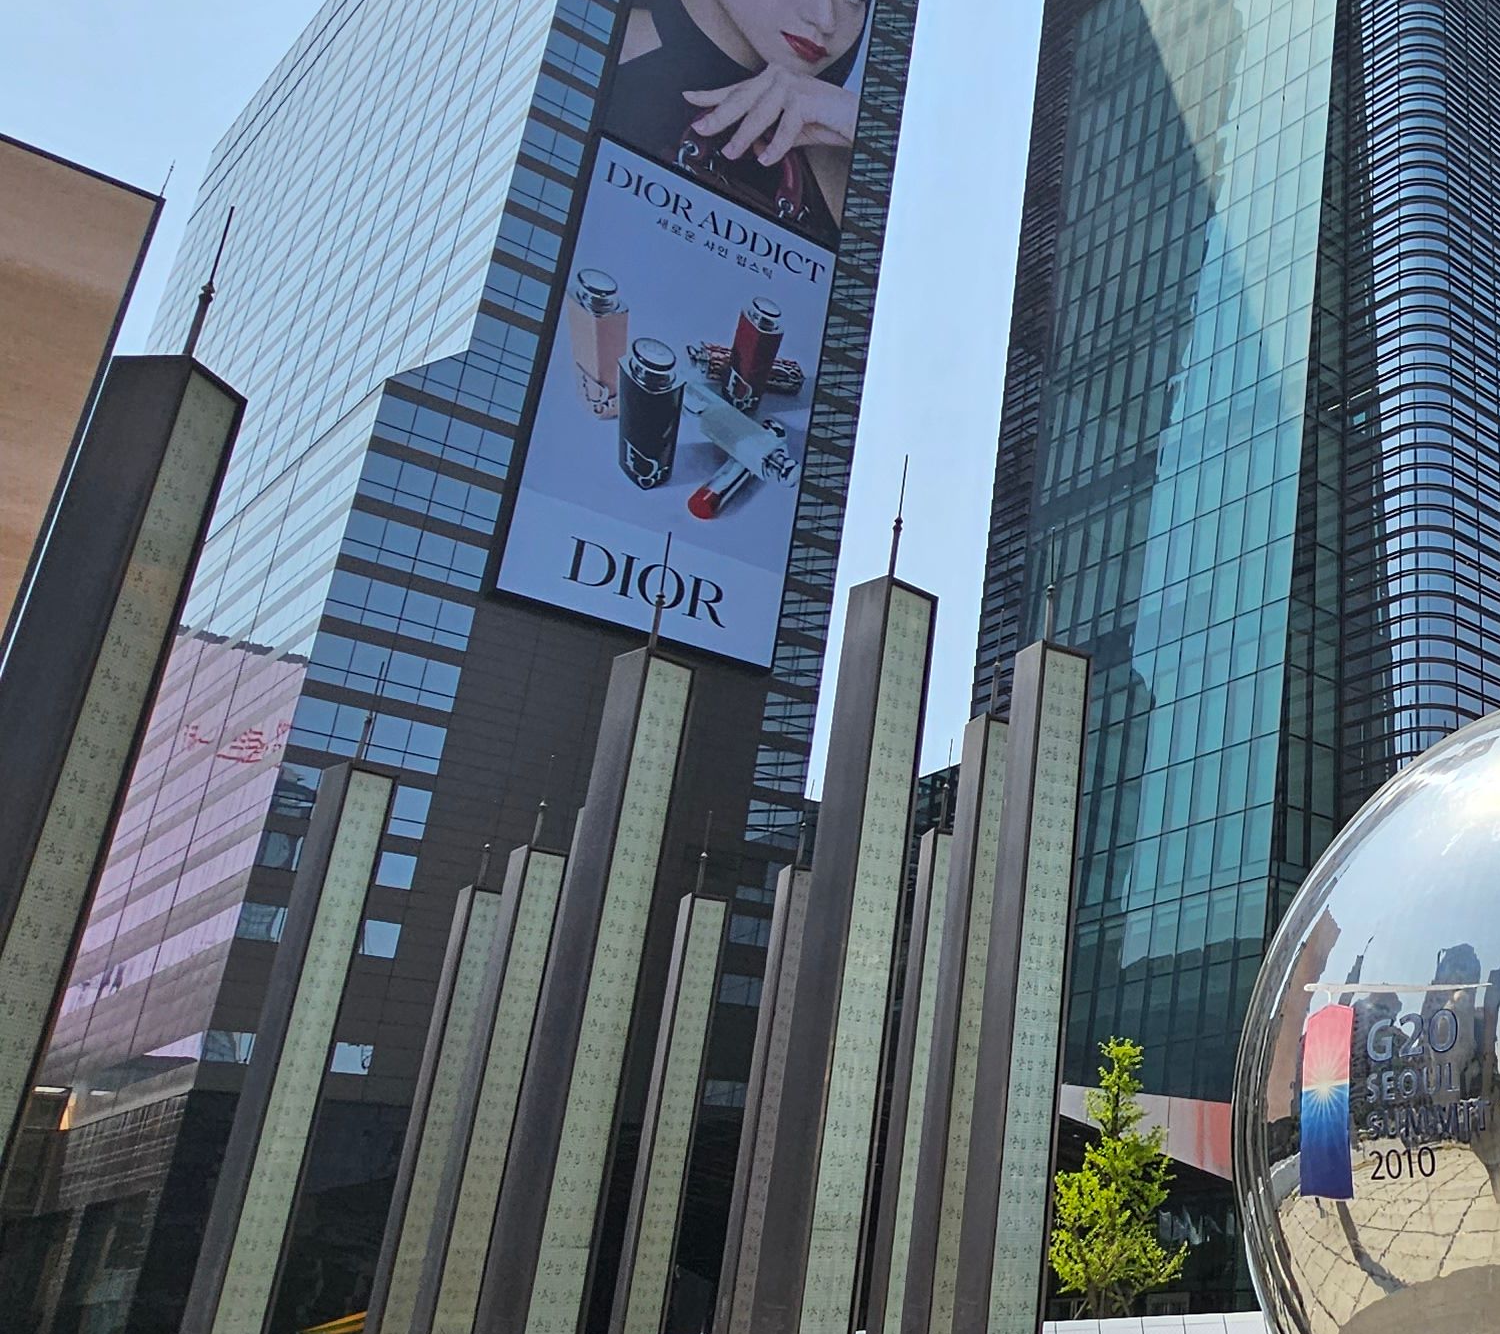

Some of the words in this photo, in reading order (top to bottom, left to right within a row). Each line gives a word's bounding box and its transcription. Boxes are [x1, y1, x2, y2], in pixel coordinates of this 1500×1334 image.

[602, 160, 693, 224] DIOR
[697, 210, 826, 285] ADDICT
[656, 217, 696, 244] 새로운
[562, 535, 727, 629] DIOR
[1366, 1008, 1459, 1063] G20
[1365, 1062, 1461, 1104] SEOUL
[1366, 1099, 1492, 1144] SUMMIT
[1368, 1146, 1437, 1181] 2010
